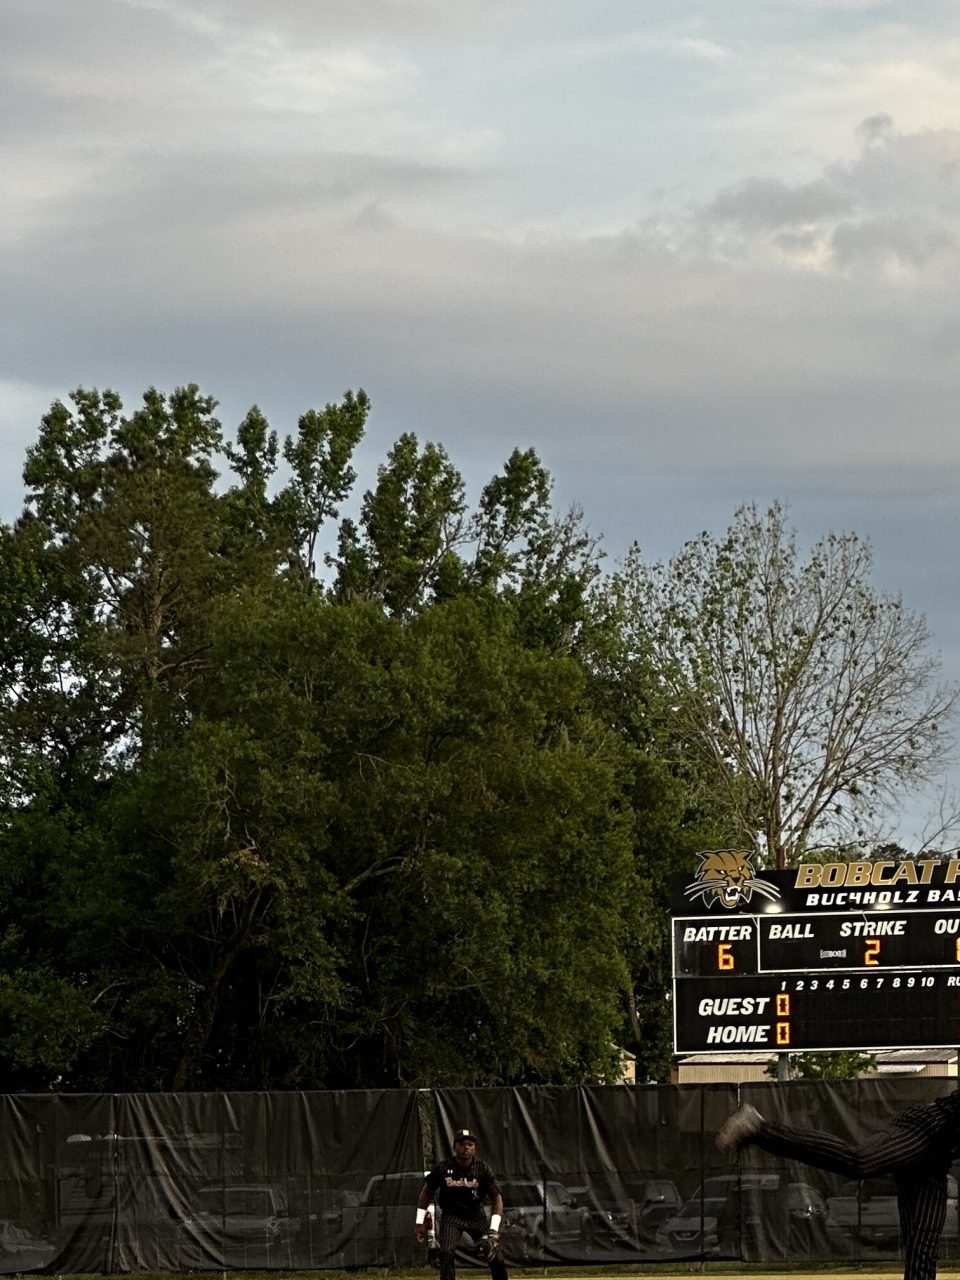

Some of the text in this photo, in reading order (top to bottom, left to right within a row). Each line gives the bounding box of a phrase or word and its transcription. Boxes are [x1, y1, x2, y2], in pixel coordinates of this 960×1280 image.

[795, 860, 941, 888] BOBCAT
[806, 892, 919, 906] BUCHHOLZ
[684, 926, 752, 941] BATTER
[769, 924, 814, 939] BALL
[840, 921, 906, 937] STRIKE
[718, 944, 734, 970] 6
[864, 939, 880, 965] 2
[781, 981, 788, 991] 1
[796, 981, 804, 990] 2
[811, 980, 819, 990] 3
[826, 980, 836, 989] 4
[842, 979, 851, 989] 5
[860, 979, 869, 988] 6
[876, 978, 885, 988] 7
[893, 978, 902, 987] 8
[908, 977, 916, 987] 9
[921, 977, 936, 987] 10
[698, 997, 770, 1016] GUEST
[776, 994, 789, 1016] 0
[707, 1025, 769, 1044] HOME
[776, 1022, 789, 1044] 0
